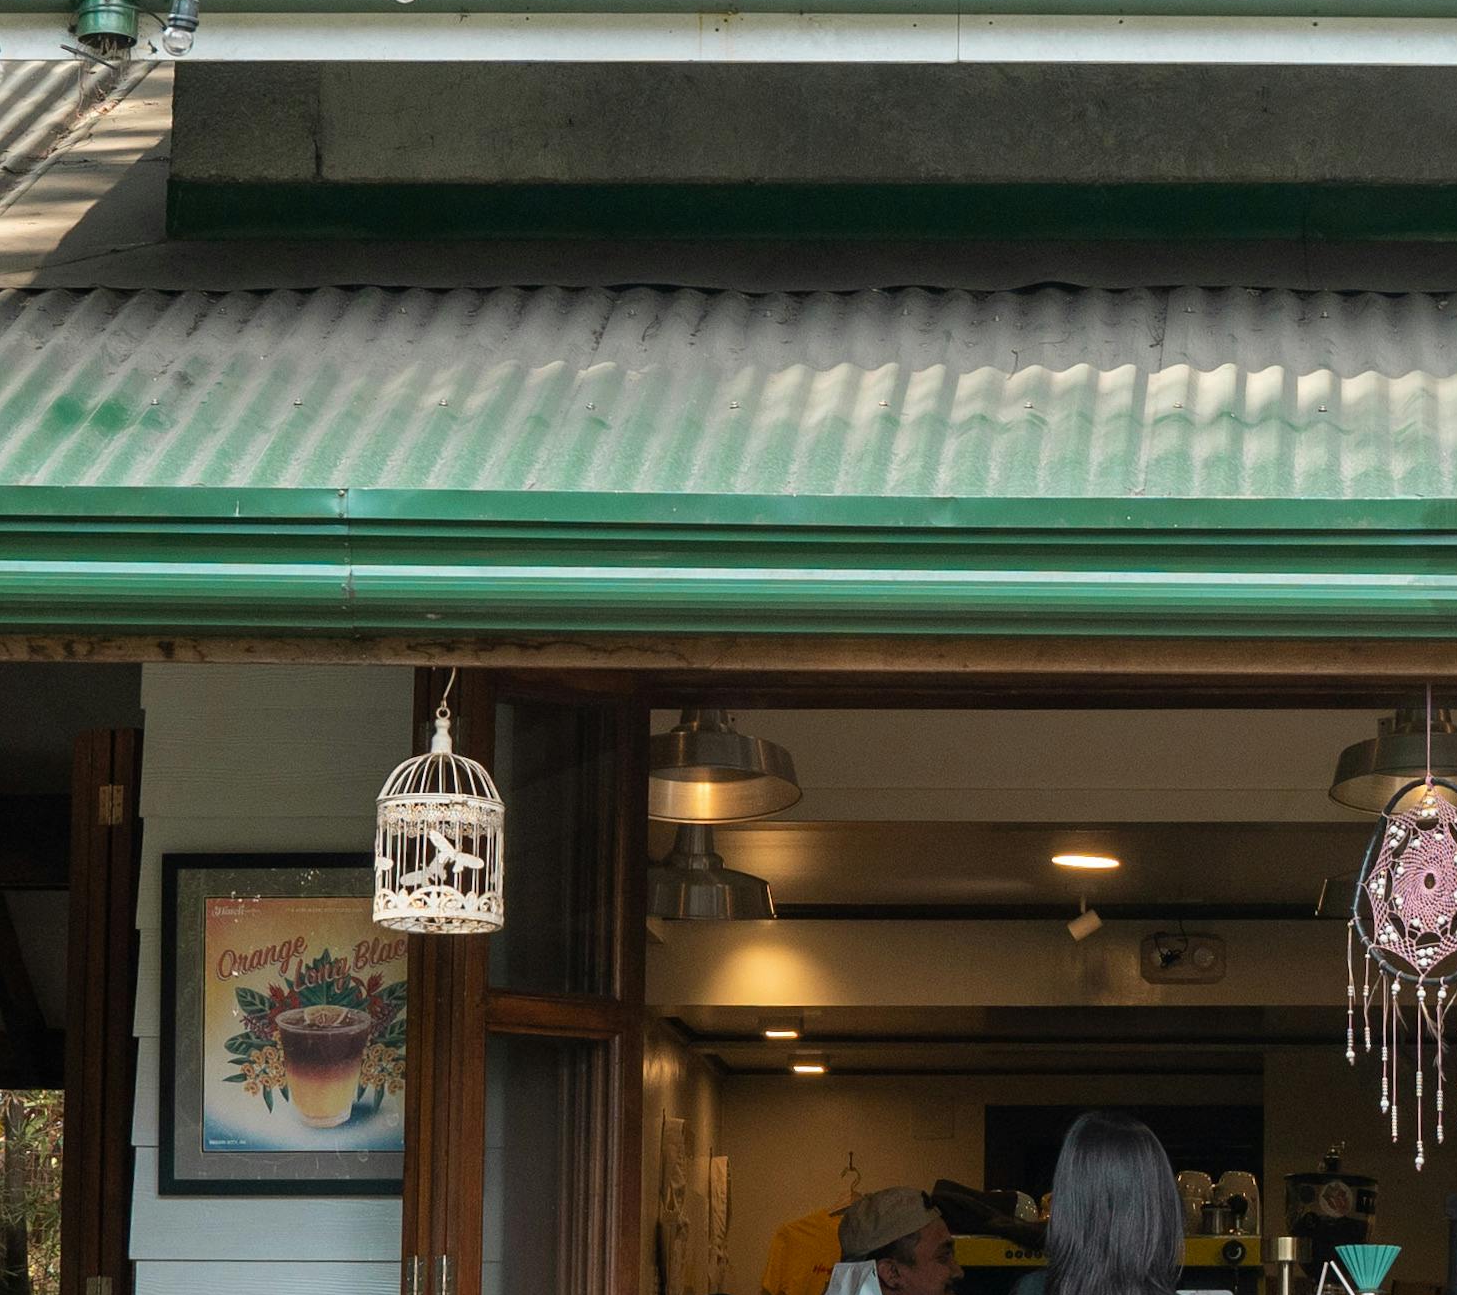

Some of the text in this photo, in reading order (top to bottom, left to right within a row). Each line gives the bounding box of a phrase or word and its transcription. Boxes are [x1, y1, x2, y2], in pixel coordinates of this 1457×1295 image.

[216, 936, 408, 993] Orange Long Blac
